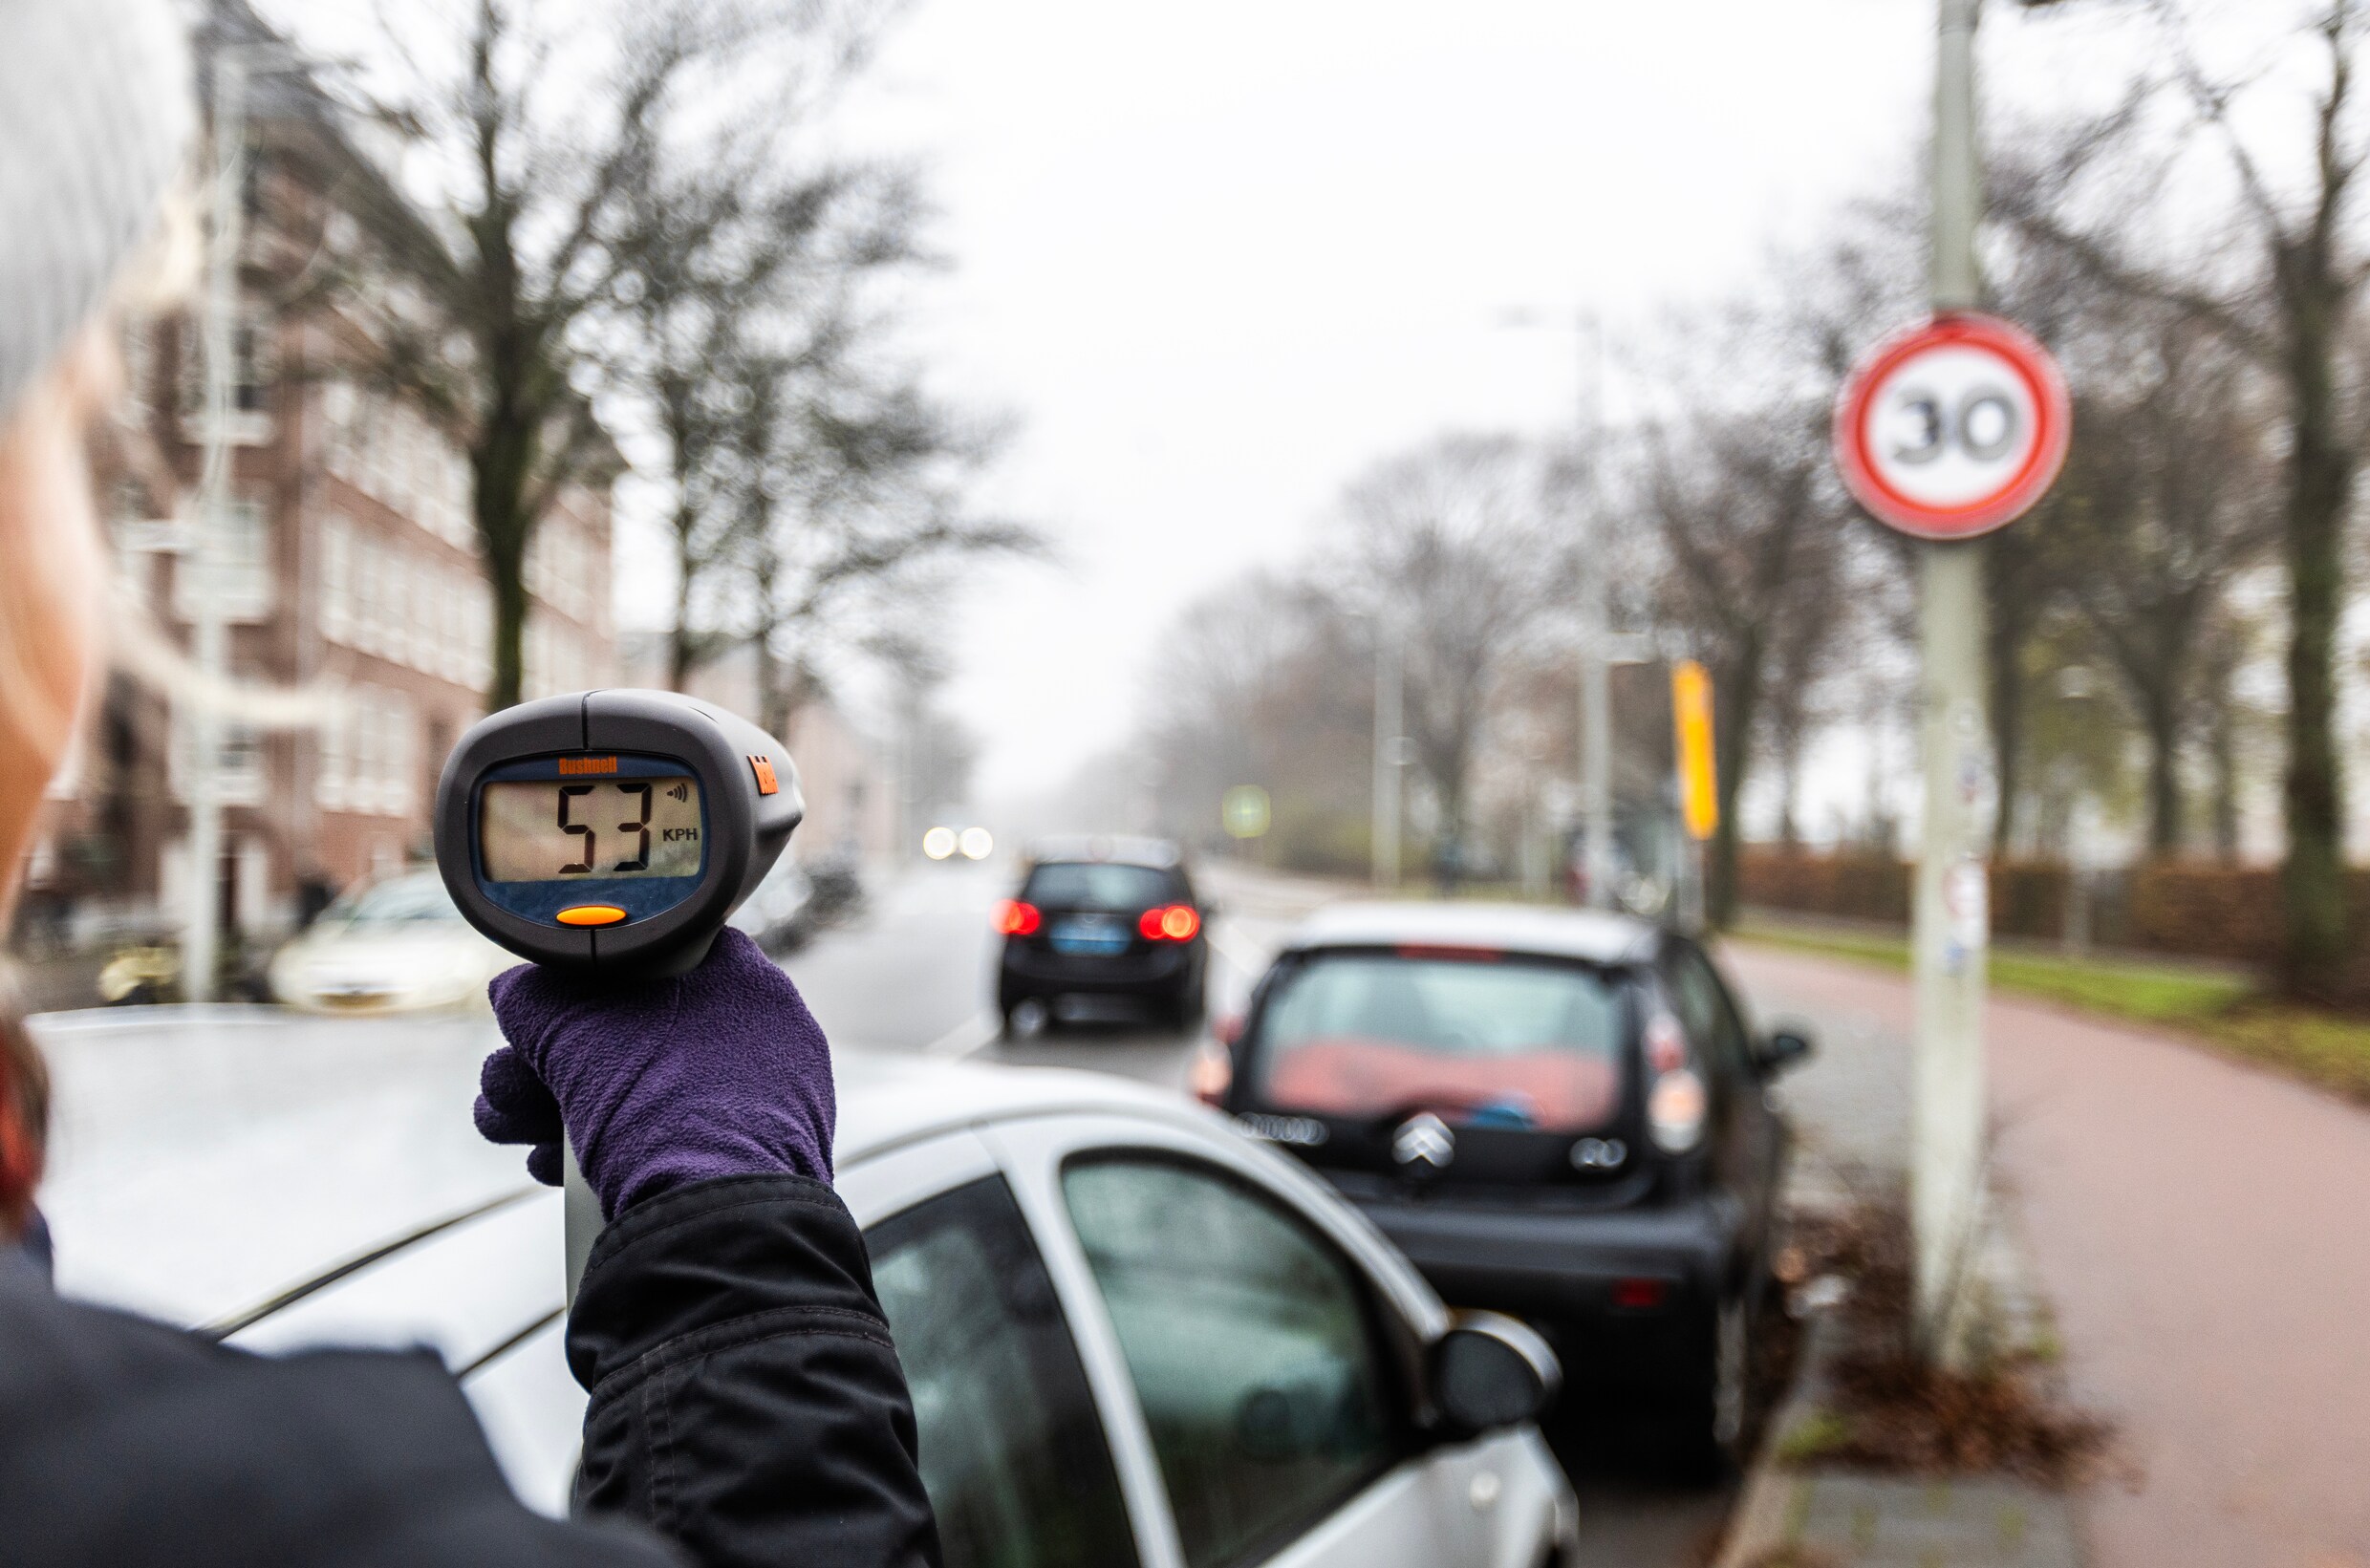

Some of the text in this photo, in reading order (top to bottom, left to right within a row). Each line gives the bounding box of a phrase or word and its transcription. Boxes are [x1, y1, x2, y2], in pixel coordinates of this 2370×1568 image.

[1891, 384, 2019, 466] 30
[558, 756, 617, 775] Bushnell
[557, 783, 698, 873] 53 KPH
